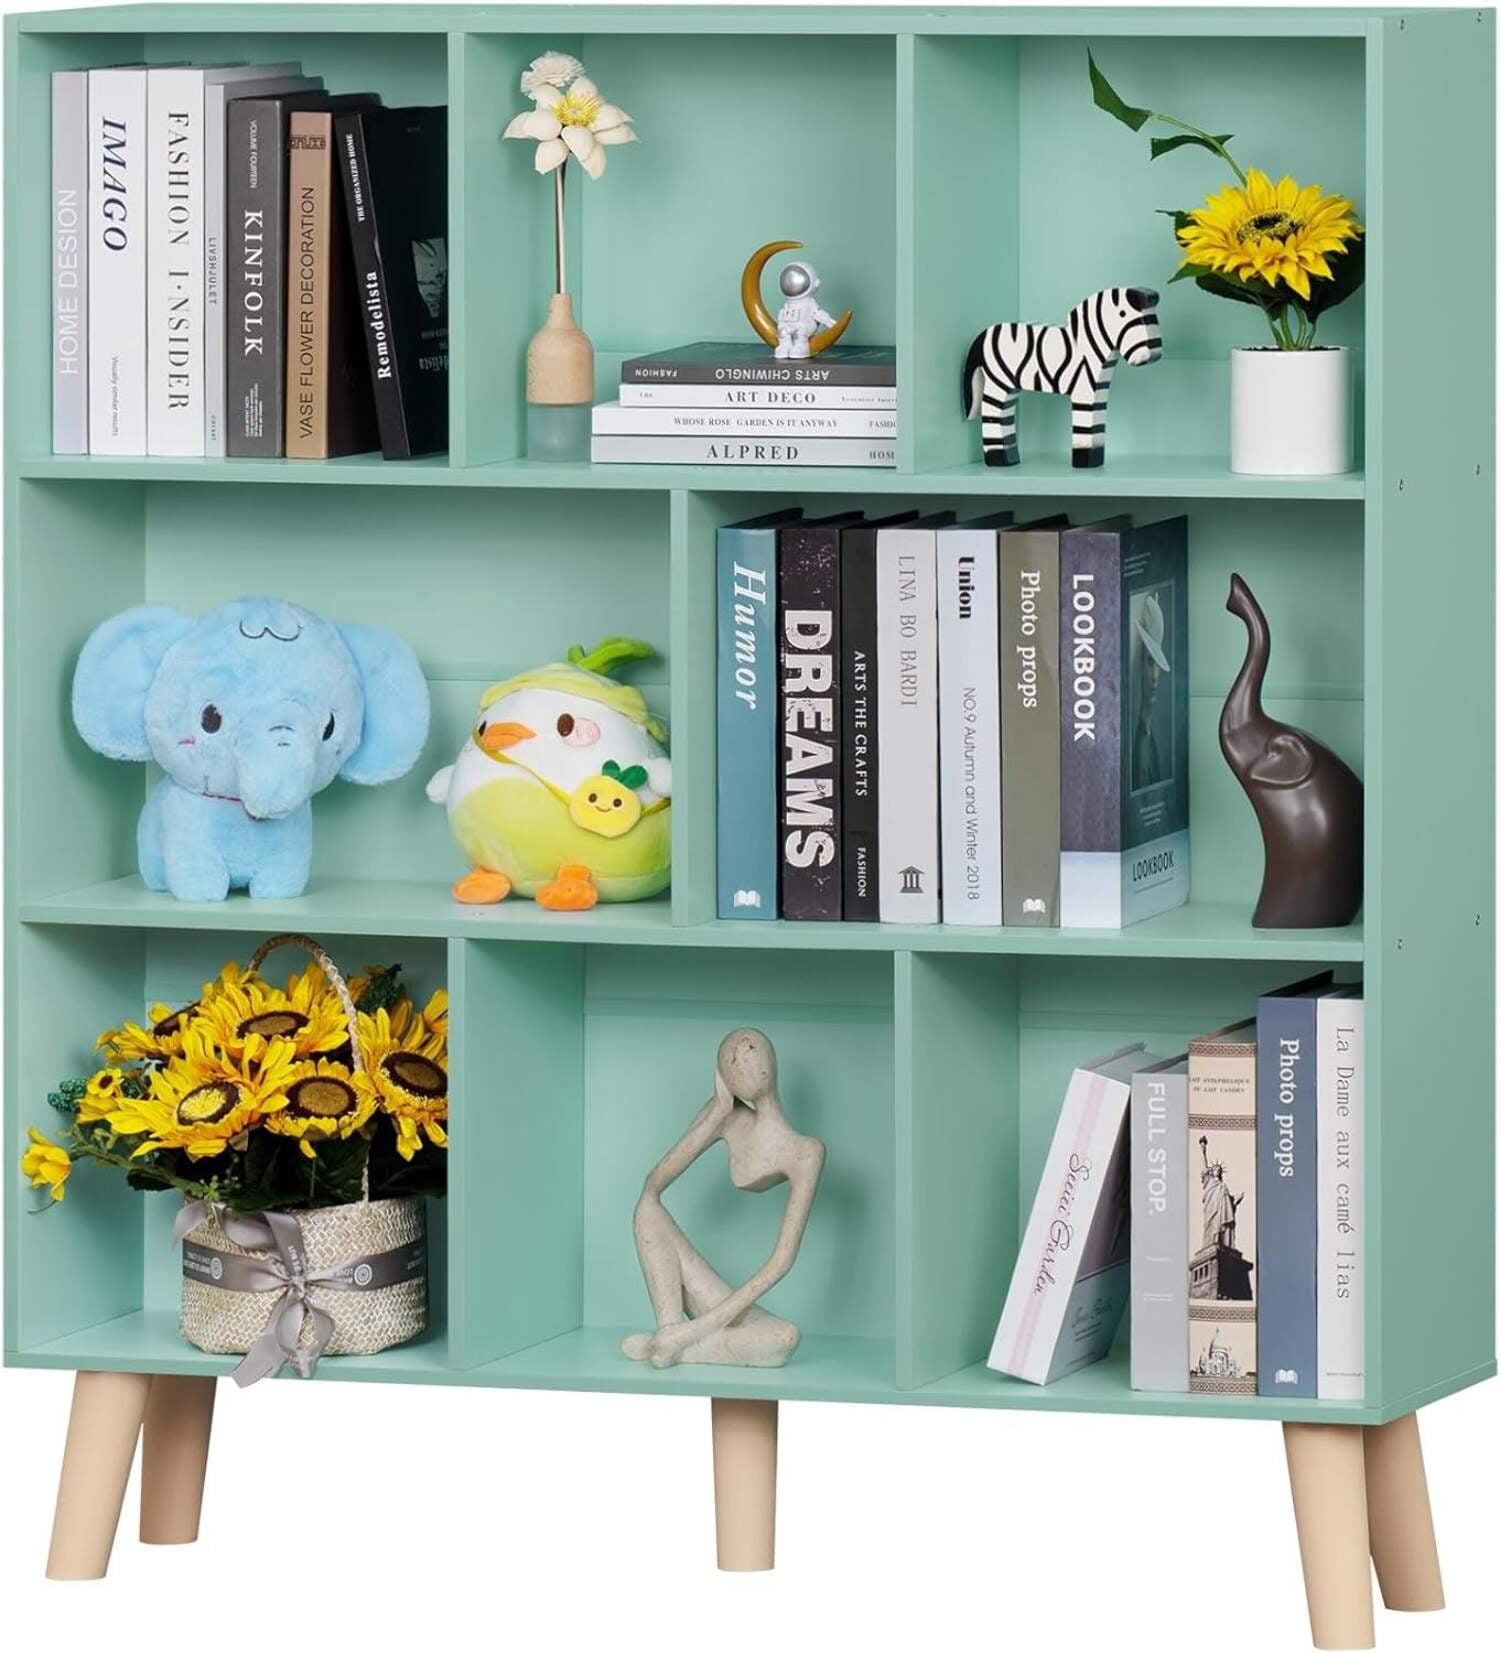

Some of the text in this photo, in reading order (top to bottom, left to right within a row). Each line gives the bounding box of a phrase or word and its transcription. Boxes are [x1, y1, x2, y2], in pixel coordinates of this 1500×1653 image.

[103, 116, 127, 251] IMAGO
[168, 112, 190, 245] FASHION
[345, 133, 356, 158] HOME
[350, 159, 363, 205] ORGANIZED
[244, 210, 263, 356] KINFOLK
[300, 187, 315, 439] VASE FLOWER DECORATION
[366, 271, 392, 380] Remodelista
[59, 297, 78, 374] HOME
[715, 368, 830, 380] ARTS CHIWINGLO
[673, 417, 705, 425] WHOSE
[708, 418, 730, 426] ROSE
[736, 418, 774, 427] GARDEN
[799, 419, 837, 428] ANYWAY
[725, 391, 816, 404] ART DECO
[707, 444, 798, 460] ALPRED
[899, 556, 917, 706] LINA BO BARDI
[958, 556, 975, 620] Union
[733, 561, 767, 710] Humor
[1016, 570, 1041, 708] Photo props
[1073, 574, 1096, 741] LOOKBOOK
[785, 609, 836, 868] DREAMS
[854, 650, 868, 796] ARTS THE CRAFTS
[964, 727, 976, 782] Autumn
[965, 785, 976, 814] and
[966, 818, 979, 861] Winter
[858, 847, 867, 897] FASHION
[967, 865, 980, 900] 2018
[1132, 849, 1175, 882] LOOKBOOK
[1147, 1082, 1167, 1215] FULL STOP.
[1274, 1038, 1300, 1177] Photo props
[1336, 1027, 1356, 1298] La Dame aux camé lias
